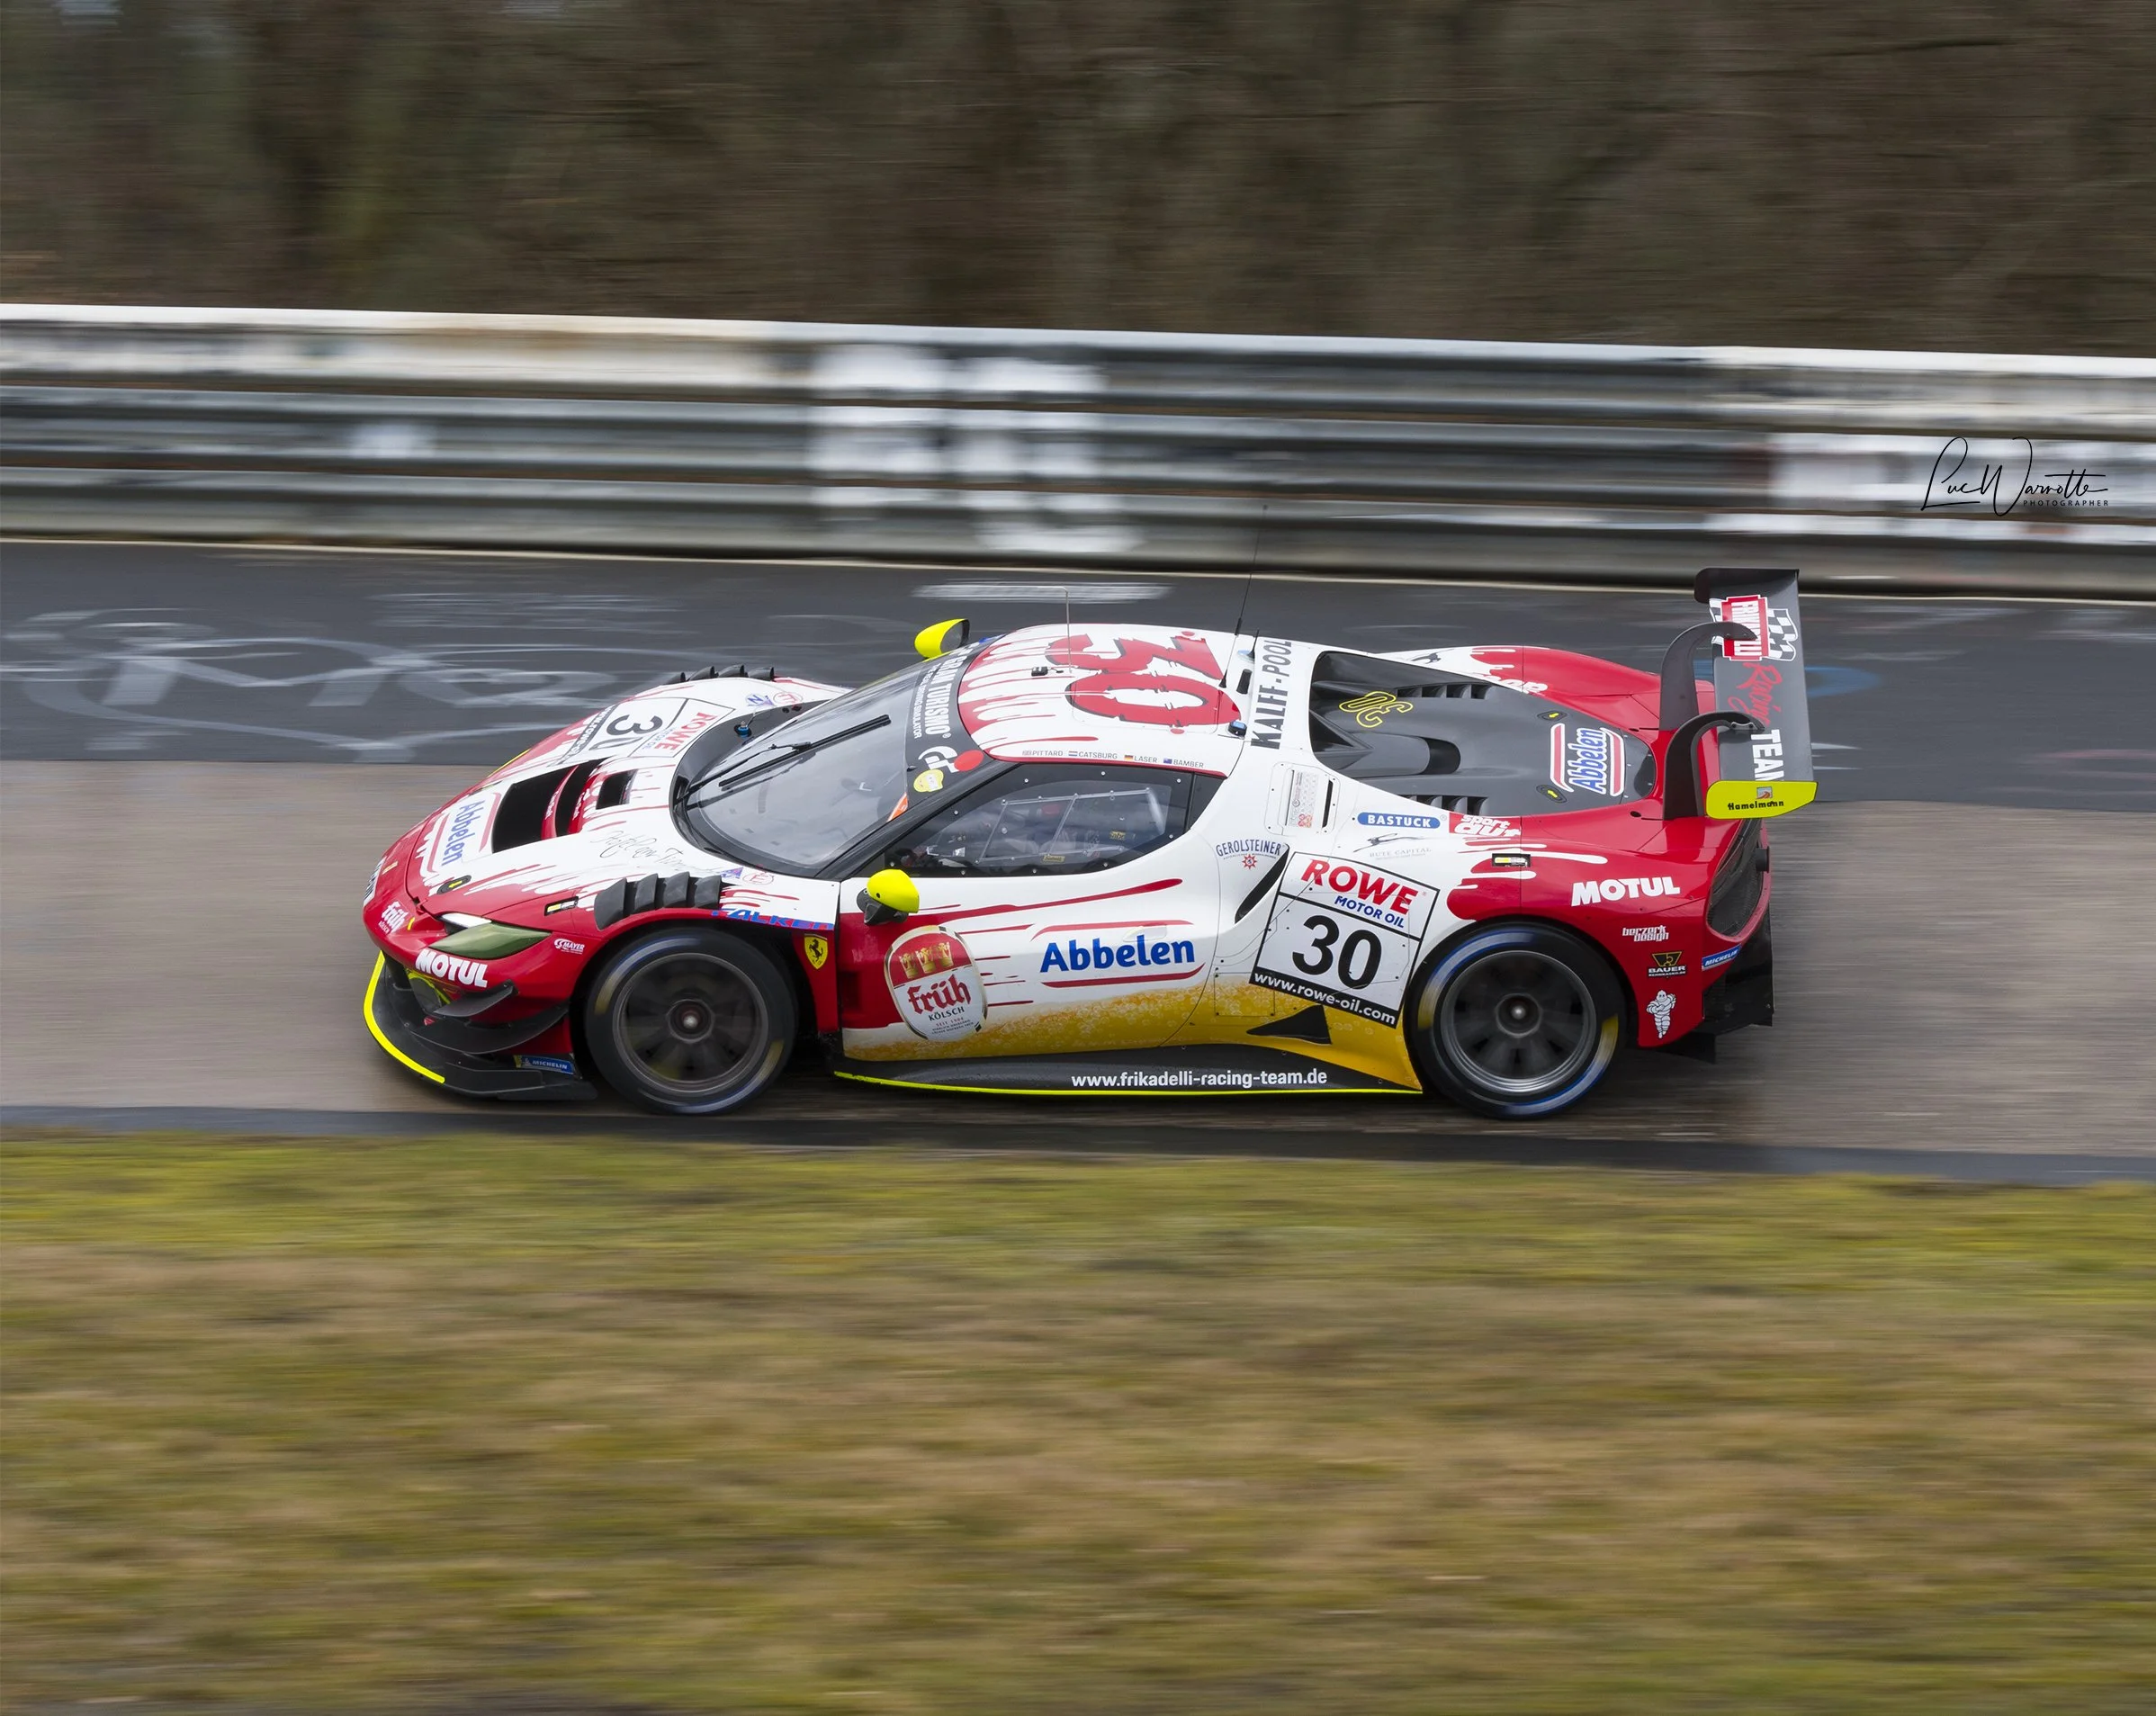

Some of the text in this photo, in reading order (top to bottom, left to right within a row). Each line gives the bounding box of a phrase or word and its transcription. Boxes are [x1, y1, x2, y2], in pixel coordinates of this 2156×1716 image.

[925, 655, 964, 734] GRAN TURISMO
[1045, 633, 1242, 727] 30
[654, 712, 718, 751] ROWE
[912, 705, 922, 738] SIMULATOR
[1078, 751, 1118, 759] CATSBURG
[1134, 755, 1158, 763] LASER
[1173, 759, 1204, 768] BAMBER
[1568, 728, 1607, 795] Abbelen
[1367, 814, 1432, 827] BASTUCK
[1728, 799, 1784, 811] Hamelmann
[442, 800, 486, 867] Abbelen
[1216, 839, 1281, 857] GEROLSTEINER
[1300, 858, 1419, 914] ROWE
[1571, 876, 1681, 907] MOTUL
[1334, 895, 1405, 928] MOTOR OIL
[562, 941, 586, 951] MAYER
[1040, 934, 1195, 973] Abbelen
[1292, 915, 1382, 990] 30
[1704, 949, 1738, 966] MICHELIN
[416, 948, 488, 988] MOTUL
[1648, 966, 1686, 974] BAUER
[928, 1006, 965, 1021] KÖLSCH
[1254, 973, 1396, 1025] www.rowe-oil.com
[532, 1060, 568, 1070] MICHELIN
[1071, 1068, 1327, 1088] www.frikadelli-racing-team.de
